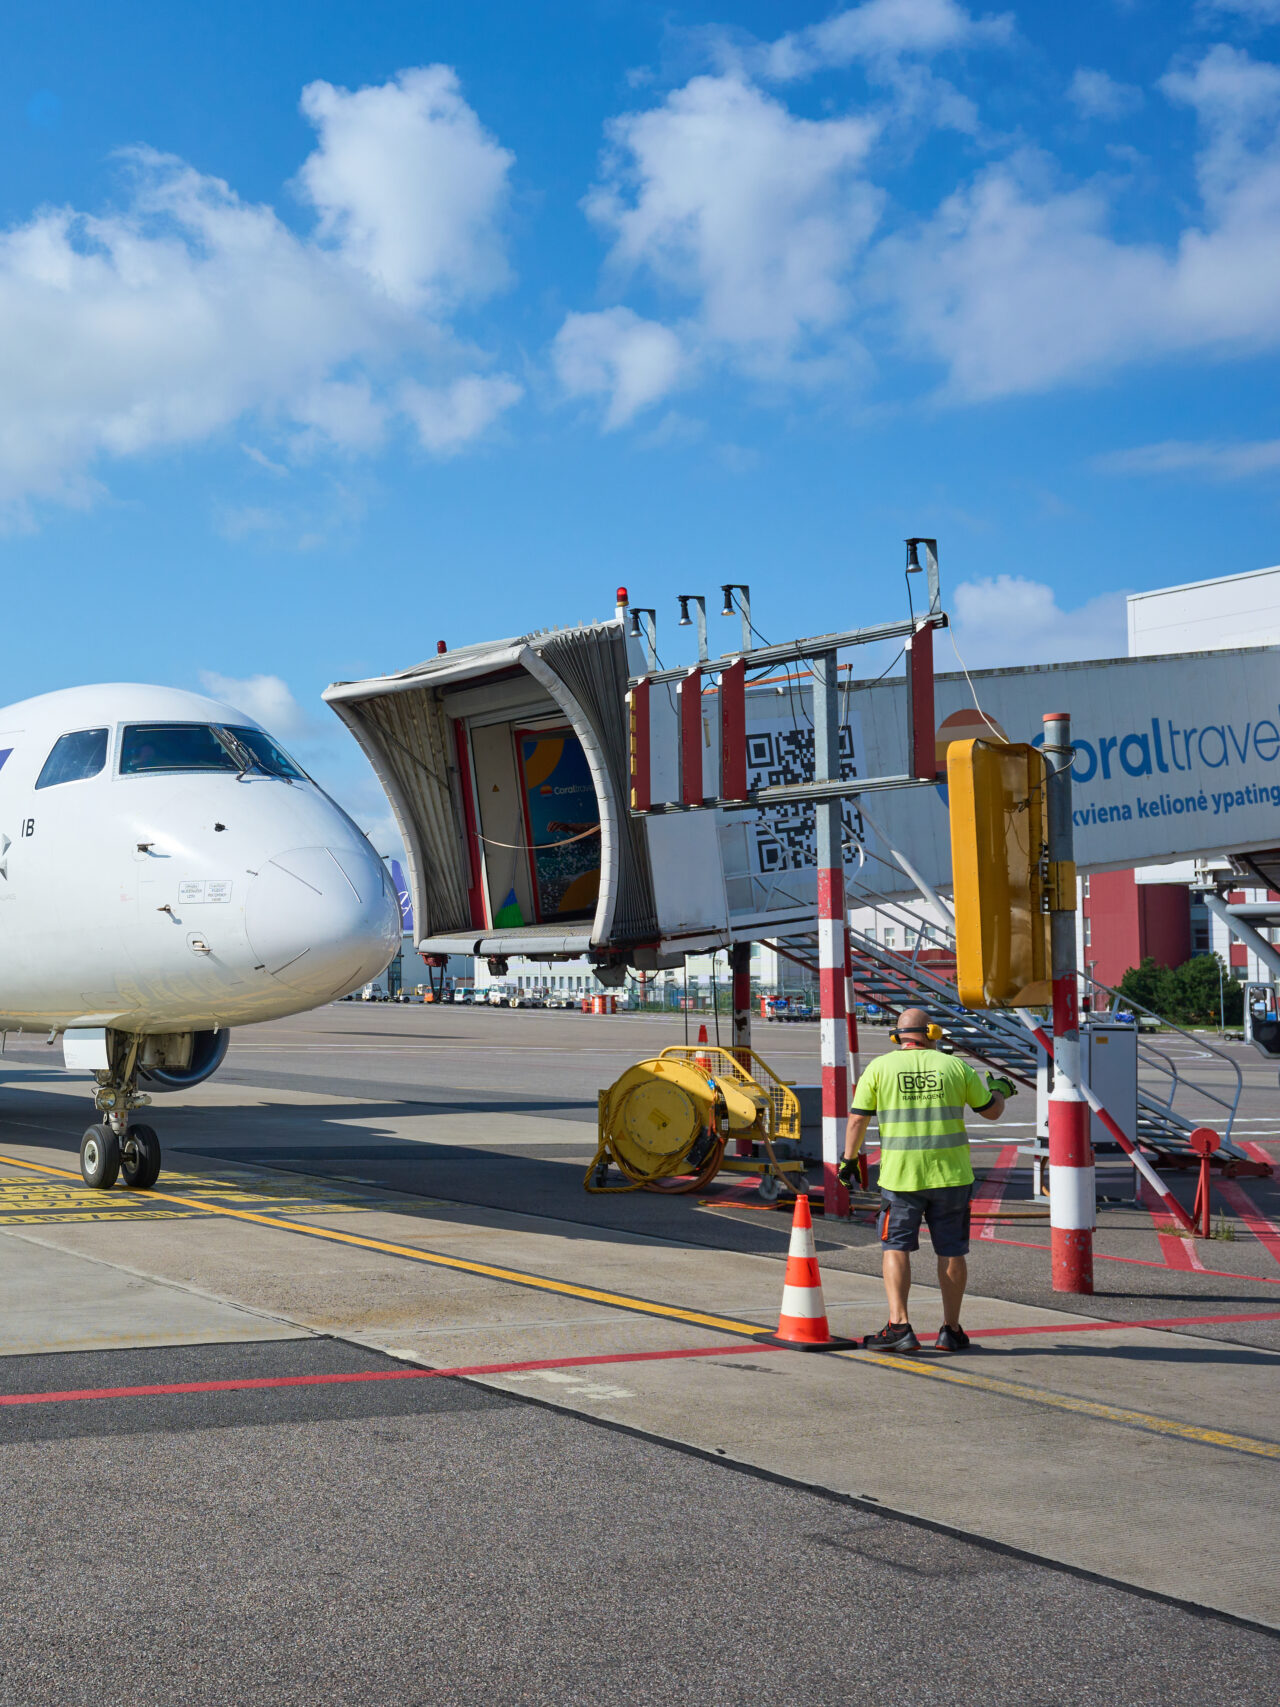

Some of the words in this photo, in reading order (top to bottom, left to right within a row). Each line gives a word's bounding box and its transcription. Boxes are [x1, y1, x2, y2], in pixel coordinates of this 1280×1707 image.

[1031, 703, 1280, 783] oraltrave
[1136, 789, 1208, 819] kelionė
[21, 818, 35, 838] IB
[903, 1074, 937, 1090] BGS
